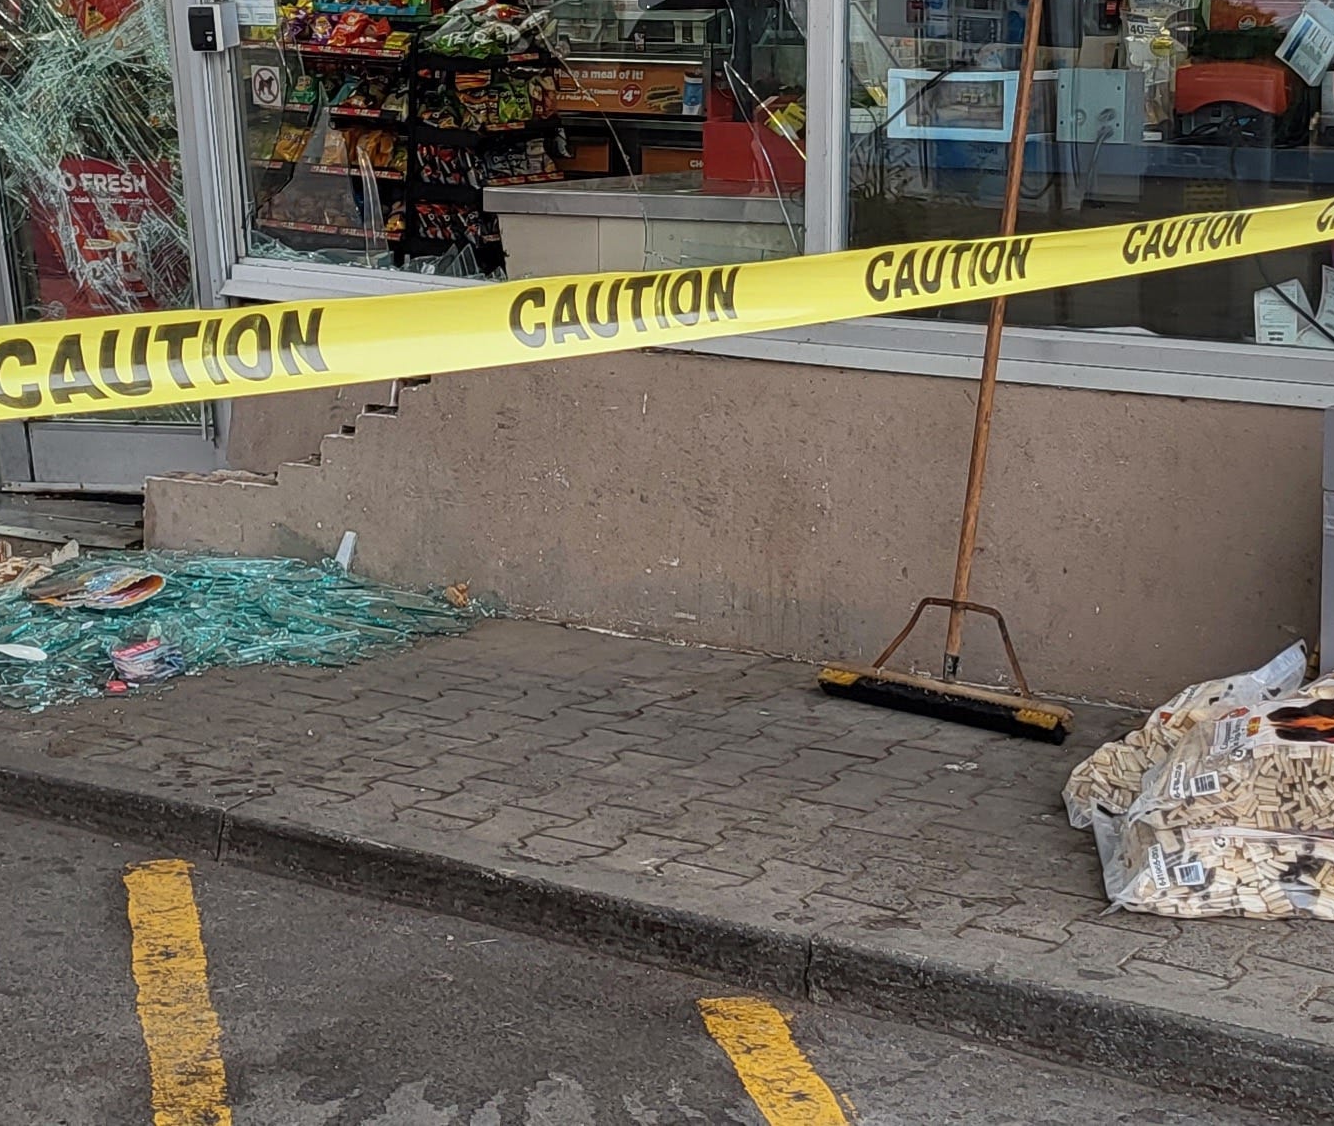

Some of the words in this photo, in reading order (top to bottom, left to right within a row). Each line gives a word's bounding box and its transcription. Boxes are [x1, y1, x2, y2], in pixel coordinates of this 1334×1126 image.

[79, 172, 147, 193] FRESH
[1122, 213, 1252, 264] CAUTION
[865, 237, 1034, 303] CAUTION
[507, 265, 743, 349] CAUTION
